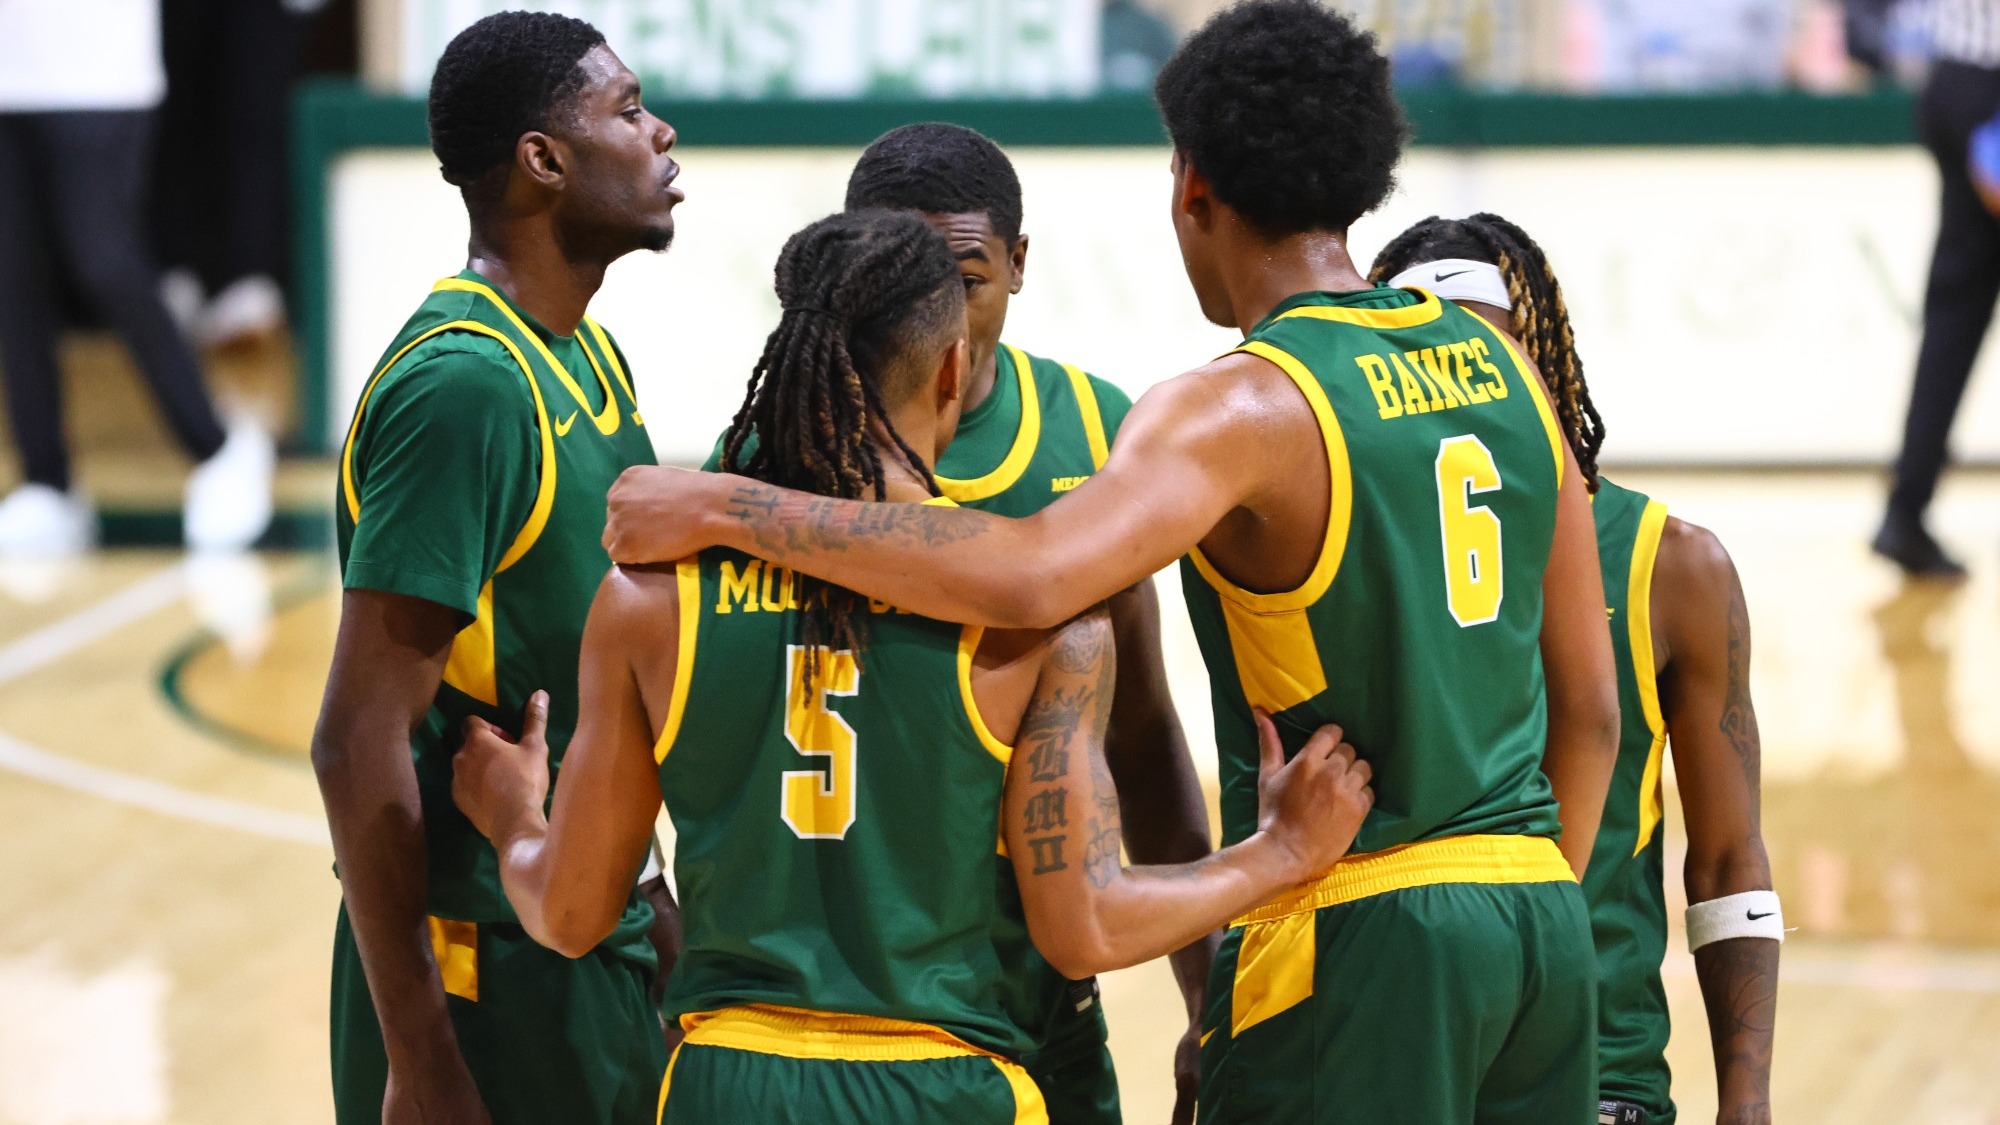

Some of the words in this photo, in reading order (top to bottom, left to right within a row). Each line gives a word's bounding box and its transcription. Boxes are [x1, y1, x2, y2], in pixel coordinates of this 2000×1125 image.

[1355, 337, 1508, 420] BAINES
[1435, 433, 1503, 627] 6
[780, 644, 860, 841] 5
[1624, 1109, 1637, 1123] M
